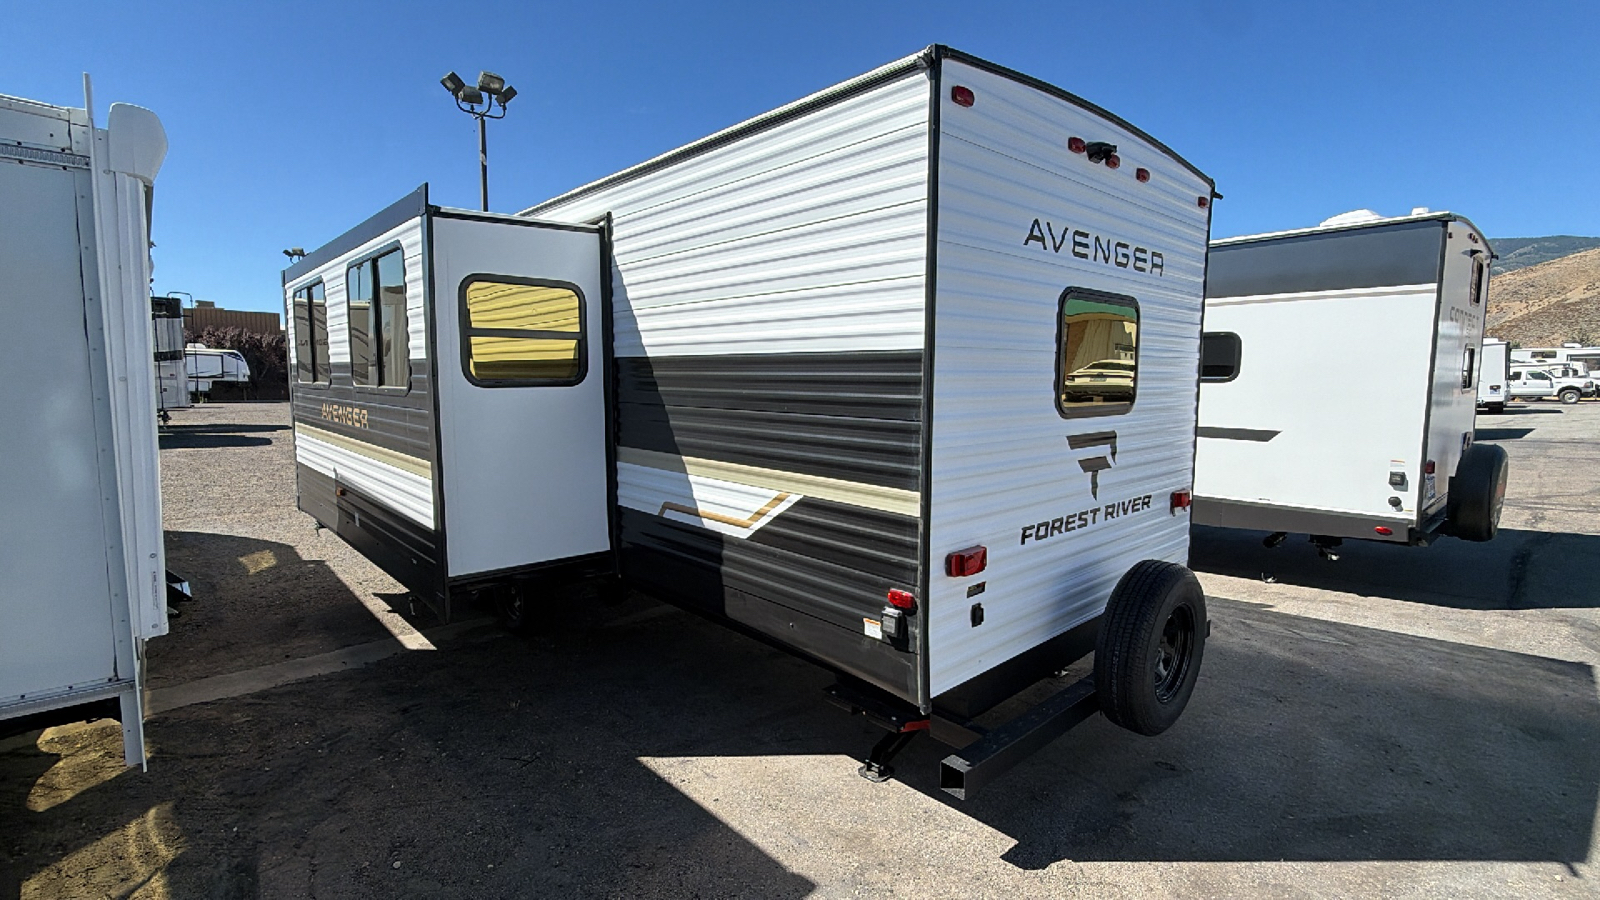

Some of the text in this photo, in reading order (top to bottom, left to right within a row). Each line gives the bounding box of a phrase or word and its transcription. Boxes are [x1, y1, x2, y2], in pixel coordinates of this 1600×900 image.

[1023, 218, 1164, 277] AVENGER
[322, 402, 369, 429] AVENGER
[1020, 494, 1152, 545] FOREST RIVER
